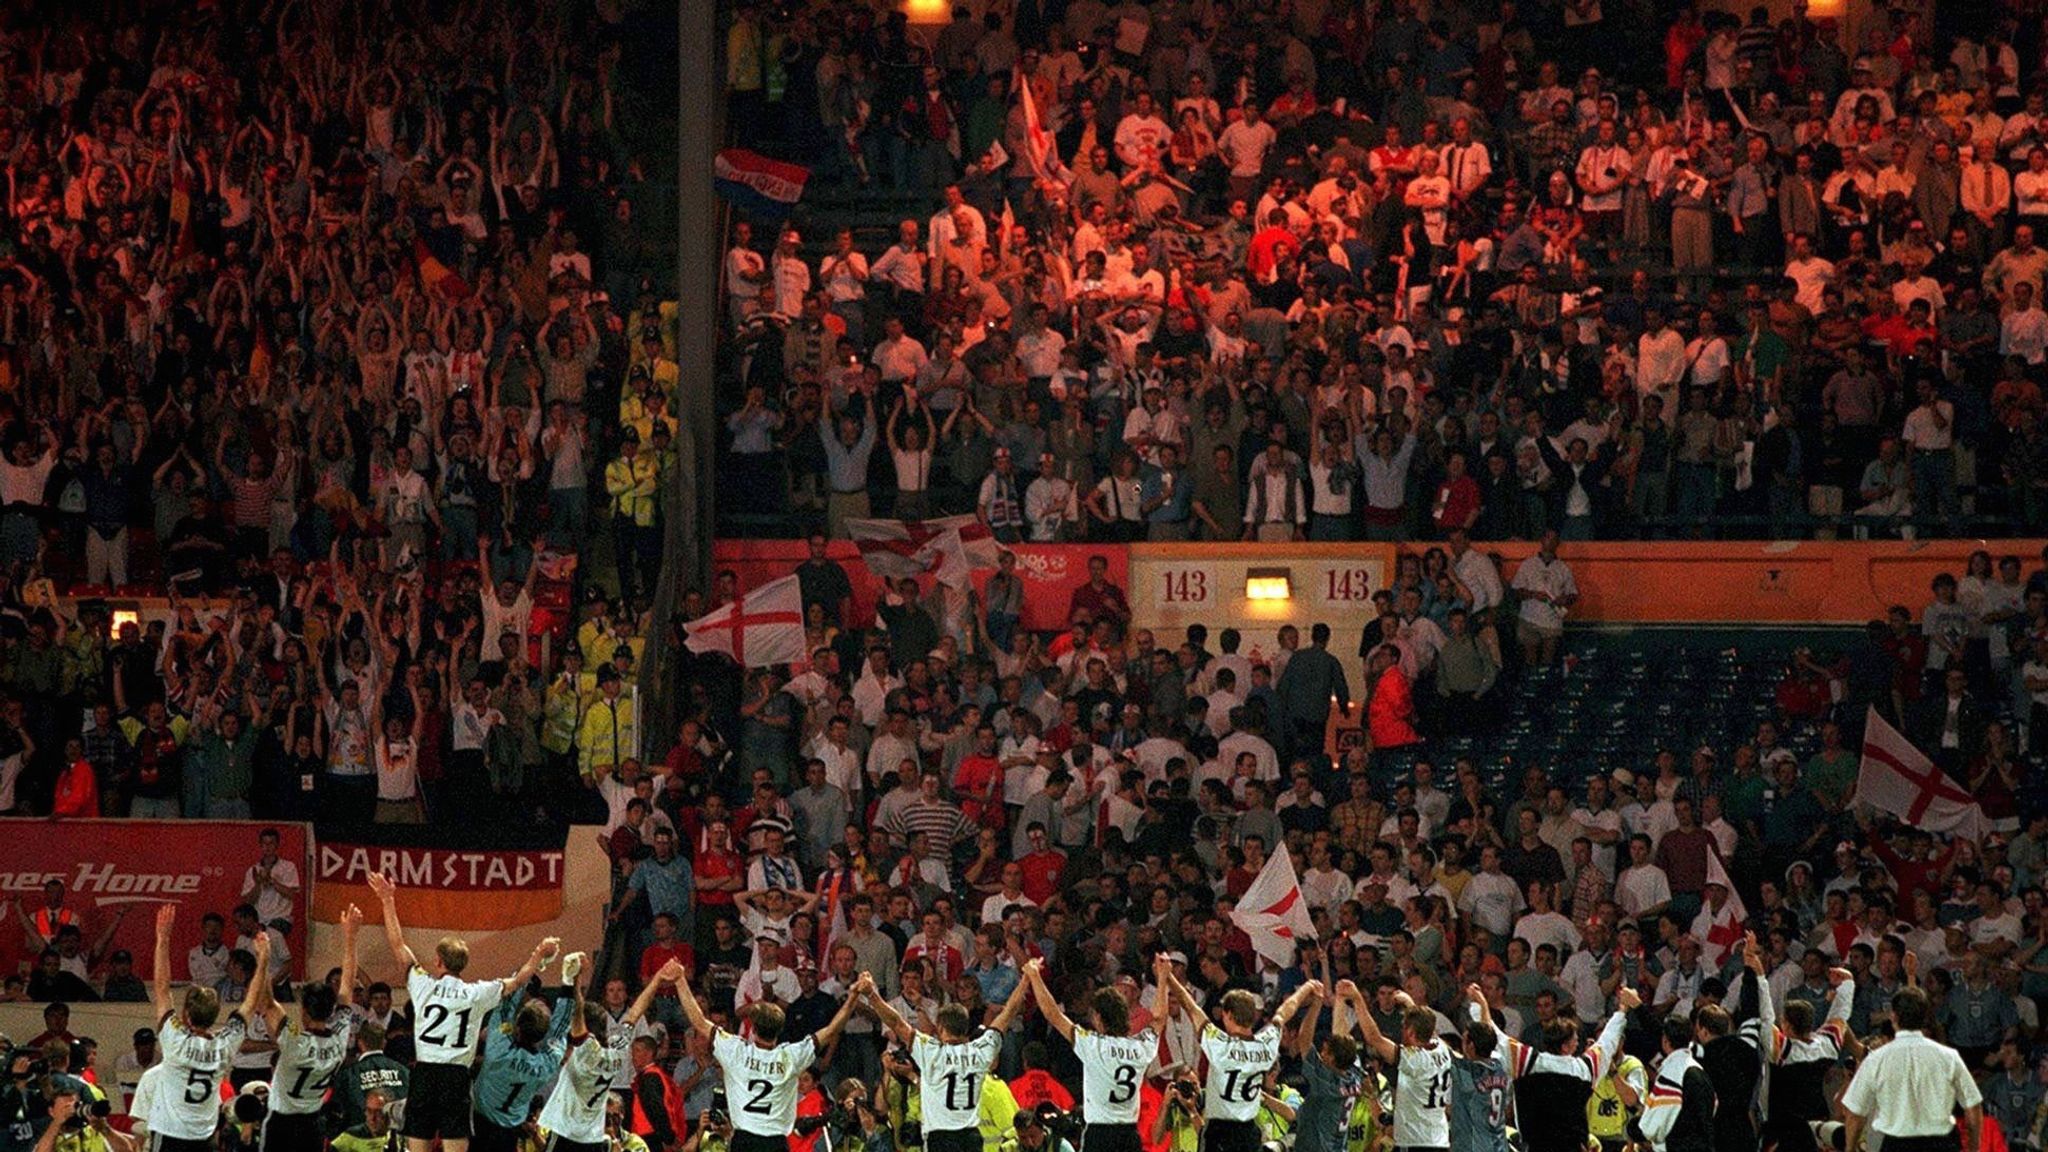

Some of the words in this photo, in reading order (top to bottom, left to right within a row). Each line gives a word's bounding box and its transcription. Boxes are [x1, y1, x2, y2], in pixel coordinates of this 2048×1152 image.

[1162, 570, 1207, 601] 143
[1327, 568, 1370, 600] 143
[72, 863, 202, 893] Home
[419, 1003, 472, 1048] 21
[184, 1069, 216, 1104] 5
[499, 1082, 527, 1114] 1
[743, 1079, 774, 1115] 2
[942, 1072, 976, 1110] 11
[1109, 1065, 1136, 1103] 3
[1220, 1069, 1267, 1102] 16
